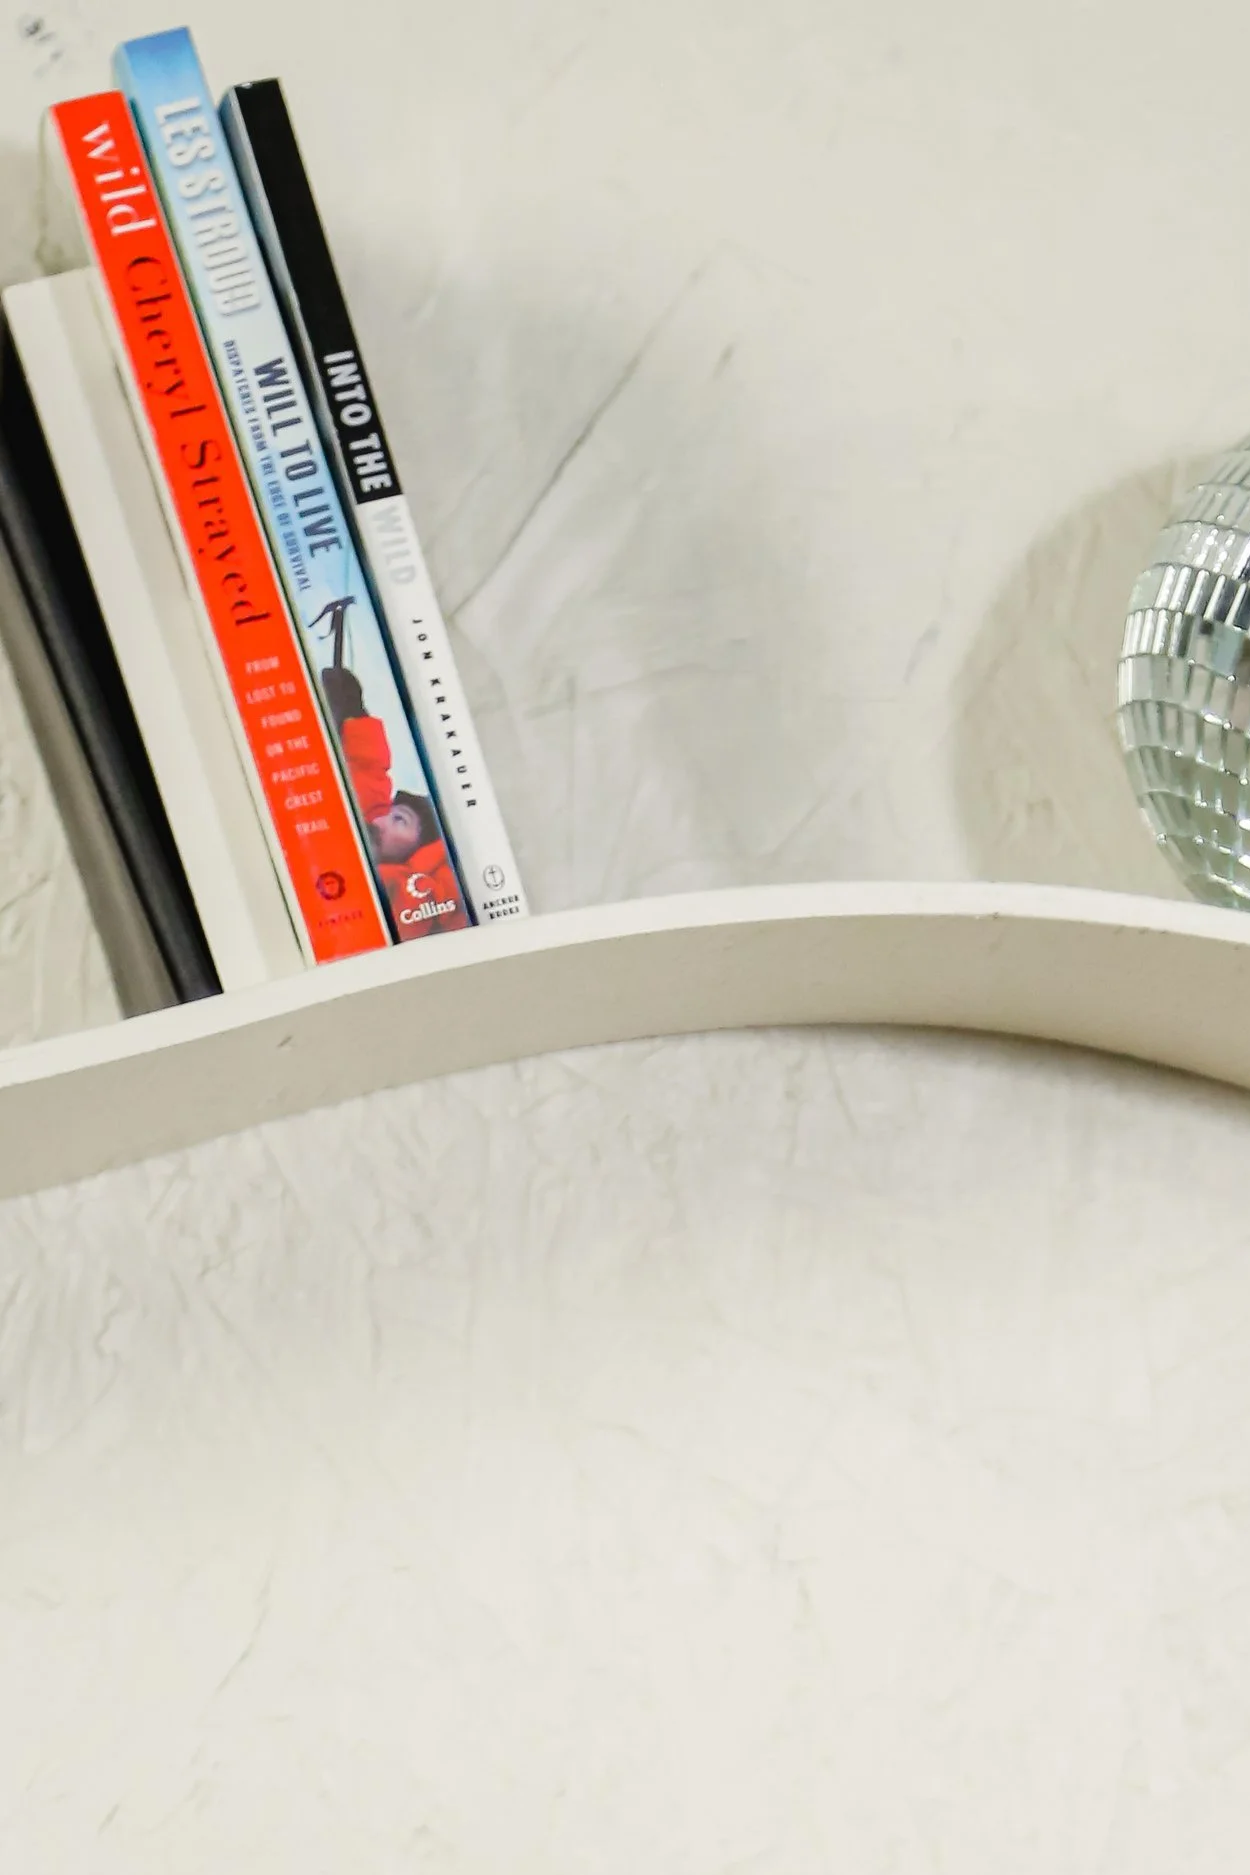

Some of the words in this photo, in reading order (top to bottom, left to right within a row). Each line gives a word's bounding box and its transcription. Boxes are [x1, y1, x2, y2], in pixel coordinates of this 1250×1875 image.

[155, 97, 215, 168] LES
[82, 120, 158, 236] wild
[178, 168, 262, 317] STROUD
[254, 356, 303, 438] WILL
[124, 256, 207, 418] Cheryl
[180, 438, 271, 626] Strayed
[280, 439, 319, 482] TO
[323, 350, 373, 427] INTO
[349, 431, 393, 493] THE
[372, 504, 417, 586] WILD
[293, 487, 343, 558] LIVE
[245, 655, 280, 675] FROM
[246, 687, 276, 705] LOST
[281, 682, 296, 698] TO
[412, 618, 433, 661] JON
[430, 676, 477, 808] KRAKAUER
[261, 709, 302, 729] FOUND
[265, 742, 285, 758] ON
[287, 735, 310, 752] THE
[271, 762, 321, 785] PACIFIC
[284, 790, 323, 811] CREST
[295, 819, 330, 837] TRAIL
[400, 897, 457, 926] Collins
